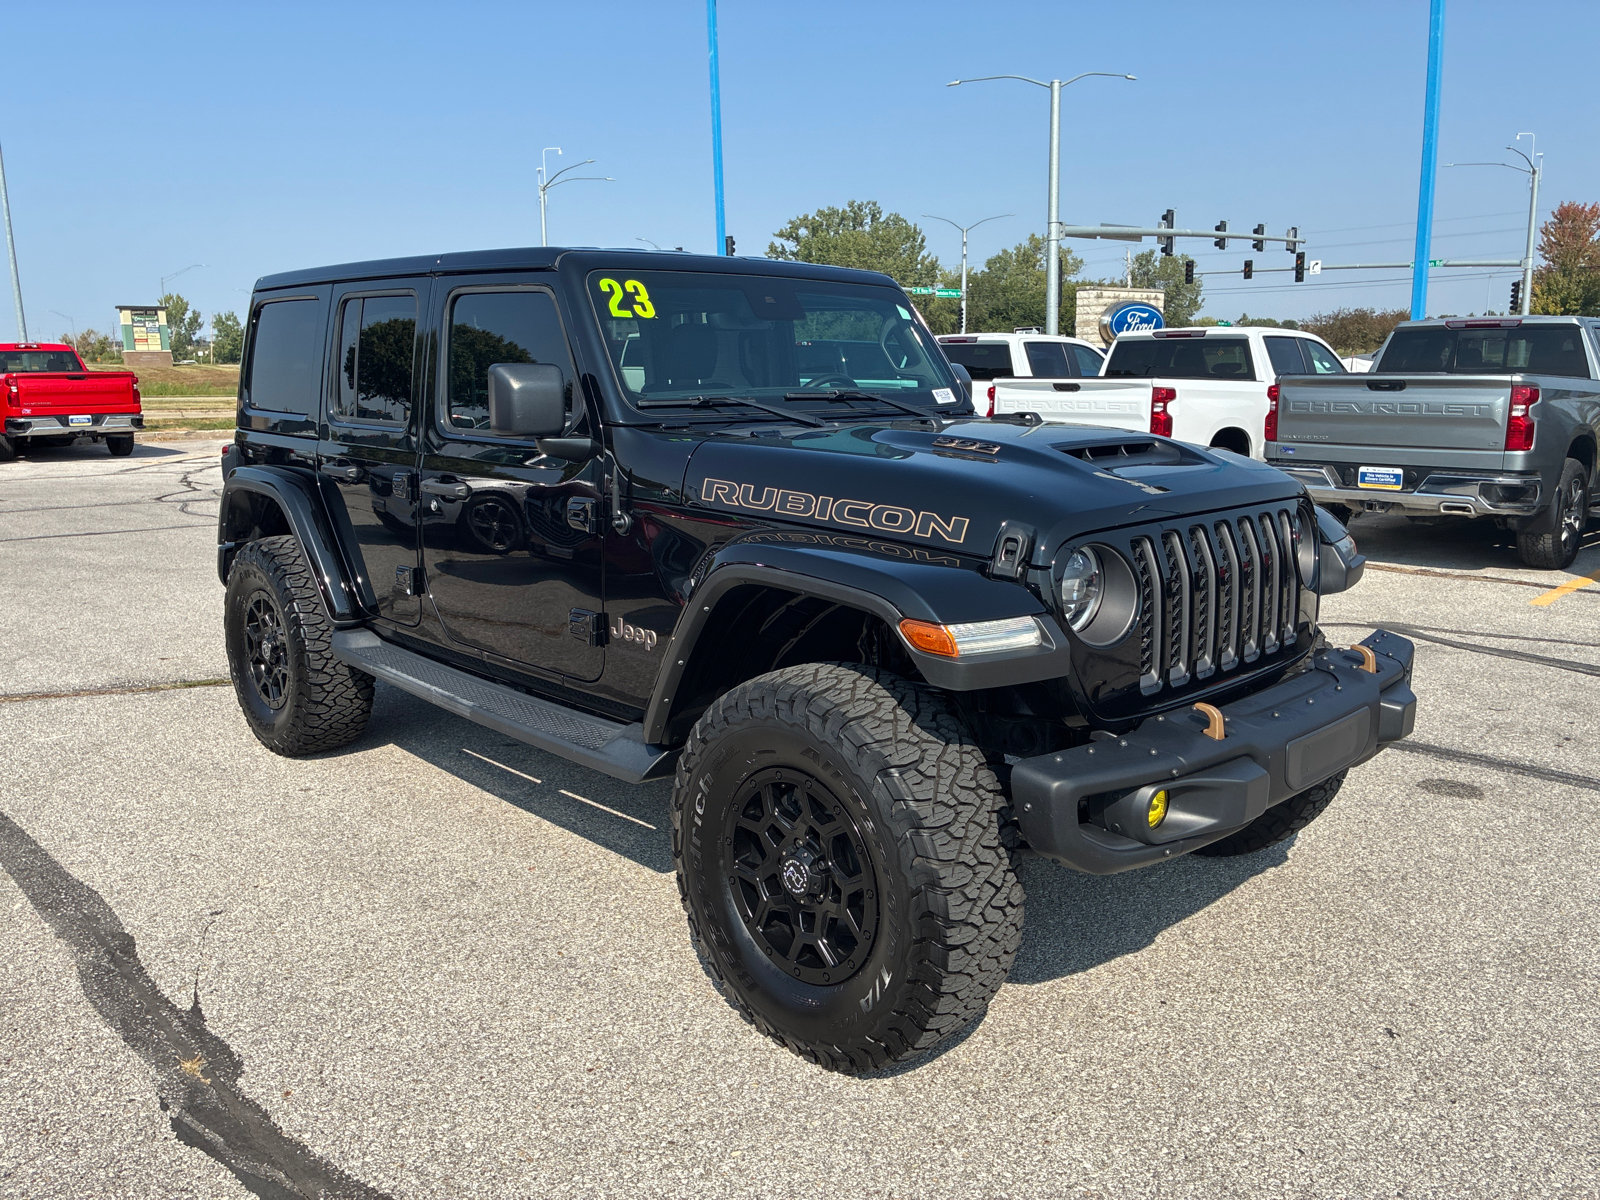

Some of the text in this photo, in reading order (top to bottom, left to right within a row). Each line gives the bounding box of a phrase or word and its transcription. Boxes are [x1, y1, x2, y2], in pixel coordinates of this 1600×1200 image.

[599, 278, 656, 319] 23
[1123, 311, 1157, 332] Ford
[1001, 399, 1138, 412] CHEVROLET
[1290, 401, 1491, 416] CHEVROLET
[701, 478, 970, 543] RUBICON
[610, 617, 657, 651] Jeep
